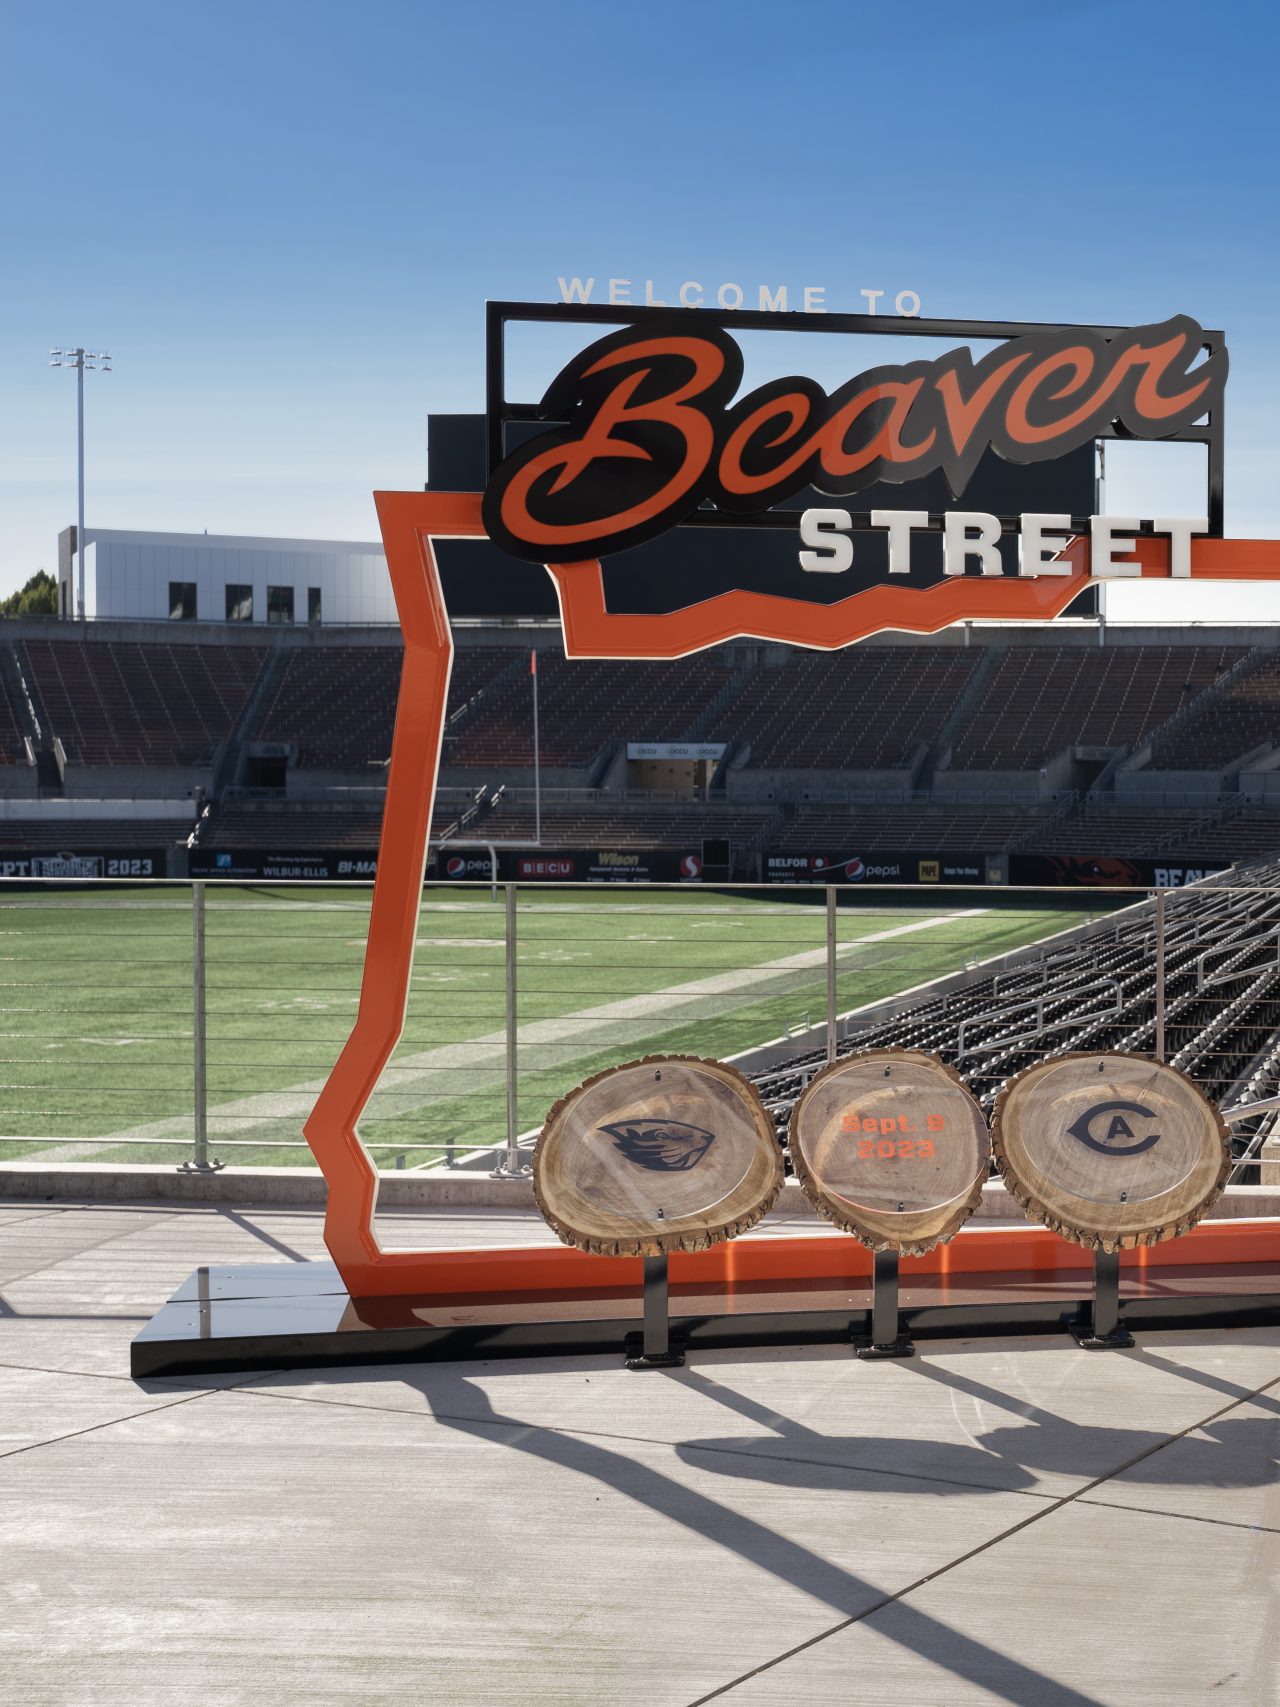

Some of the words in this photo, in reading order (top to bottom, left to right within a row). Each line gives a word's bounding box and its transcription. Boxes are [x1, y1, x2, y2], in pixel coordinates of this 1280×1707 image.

[557, 276, 827, 313] WELCOME
[860, 289, 921, 317] TO
[501, 332, 1211, 545] Beaver
[798, 508, 1209, 578] STREET
[0, 861, 29, 877] PT
[107, 859, 152, 875] 2023
[466, 859, 500, 873] pepi
[598, 852, 639, 866] Wilson
[768, 858, 808, 868] BELFOR
[262, 867, 329, 877] WILBUR-ELLIS
[866, 864, 900, 877] pepsi
[843, 1114, 917, 1136] Sept.
[857, 1140, 935, 1158] 2023
